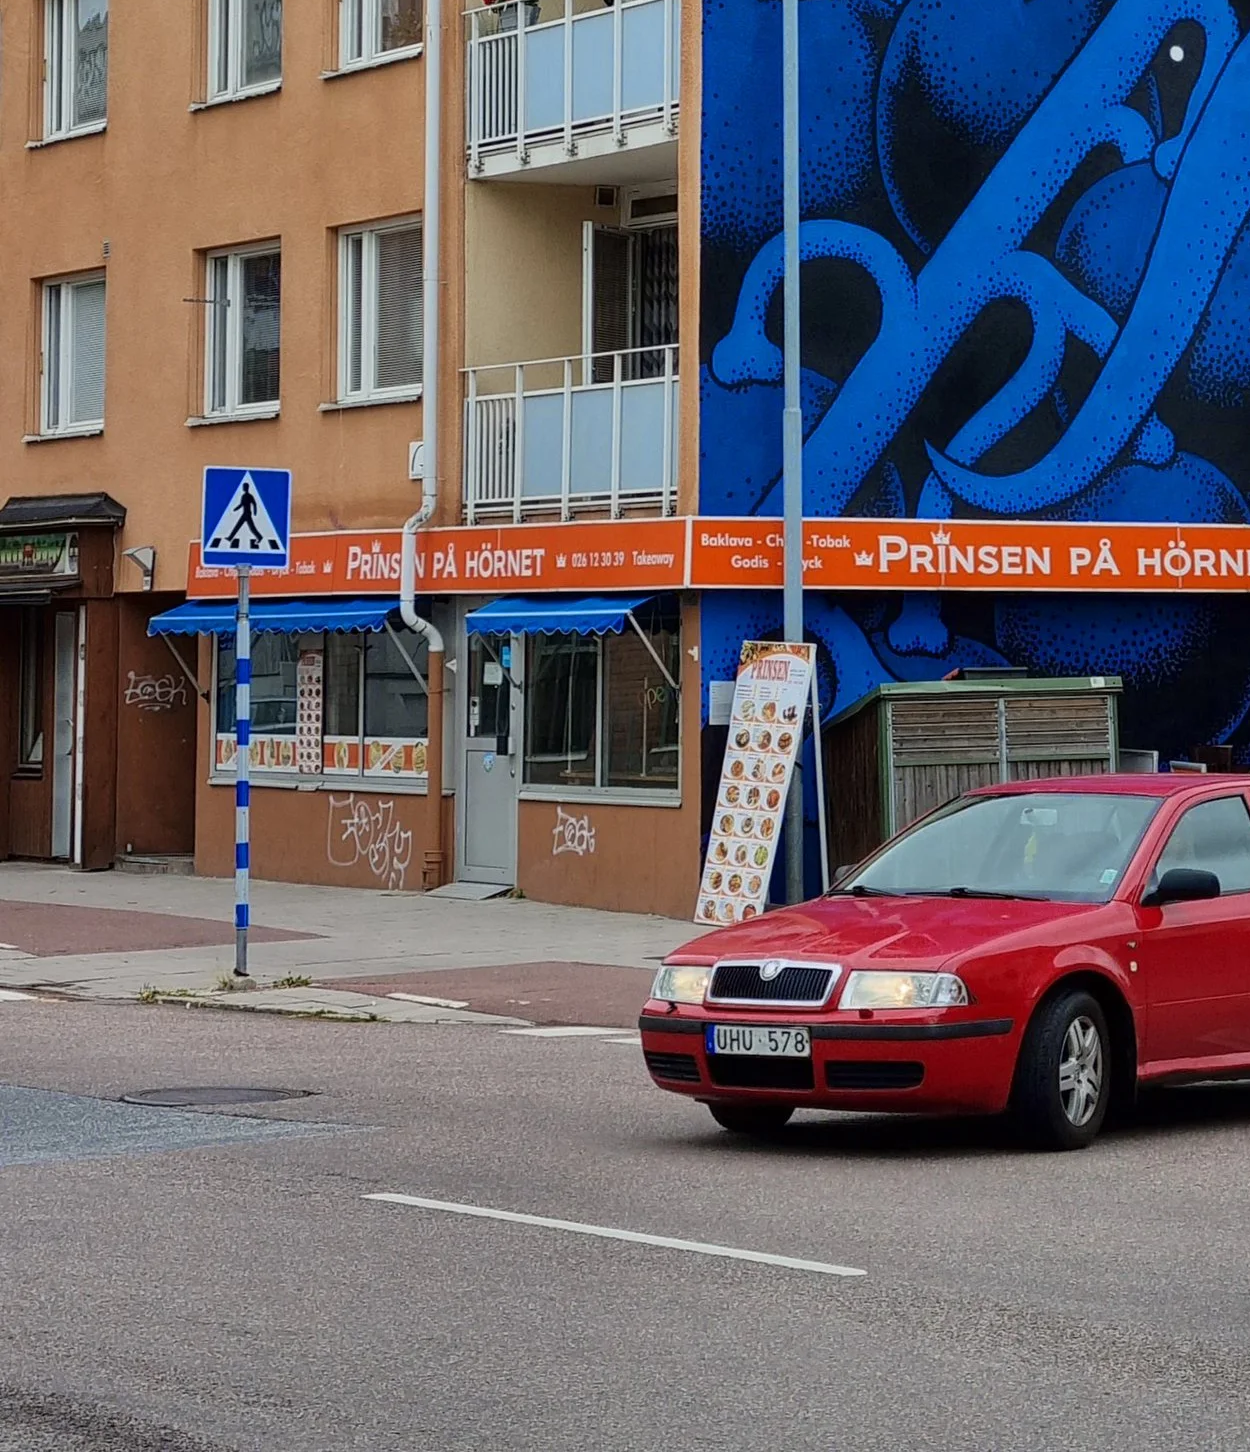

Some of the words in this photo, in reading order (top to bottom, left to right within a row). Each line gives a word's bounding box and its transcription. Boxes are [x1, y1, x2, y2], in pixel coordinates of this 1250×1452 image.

[700, 533, 753, 547] Baklava
[432, 542, 458, 579] PÅ
[465, 542, 545, 579] HÖRNET
[571, 552, 588, 568] 026
[589, 552, 600, 567] 12
[600, 552, 612, 567] 30
[613, 551, 625, 566] 39
[632, 550, 675, 568] Takeaway
[731, 555, 769, 569] Godis
[1069, 538, 1121, 576] PÅ
[717, 1029, 753, 1051] UHU
[767, 1030, 805, 1053] 578
